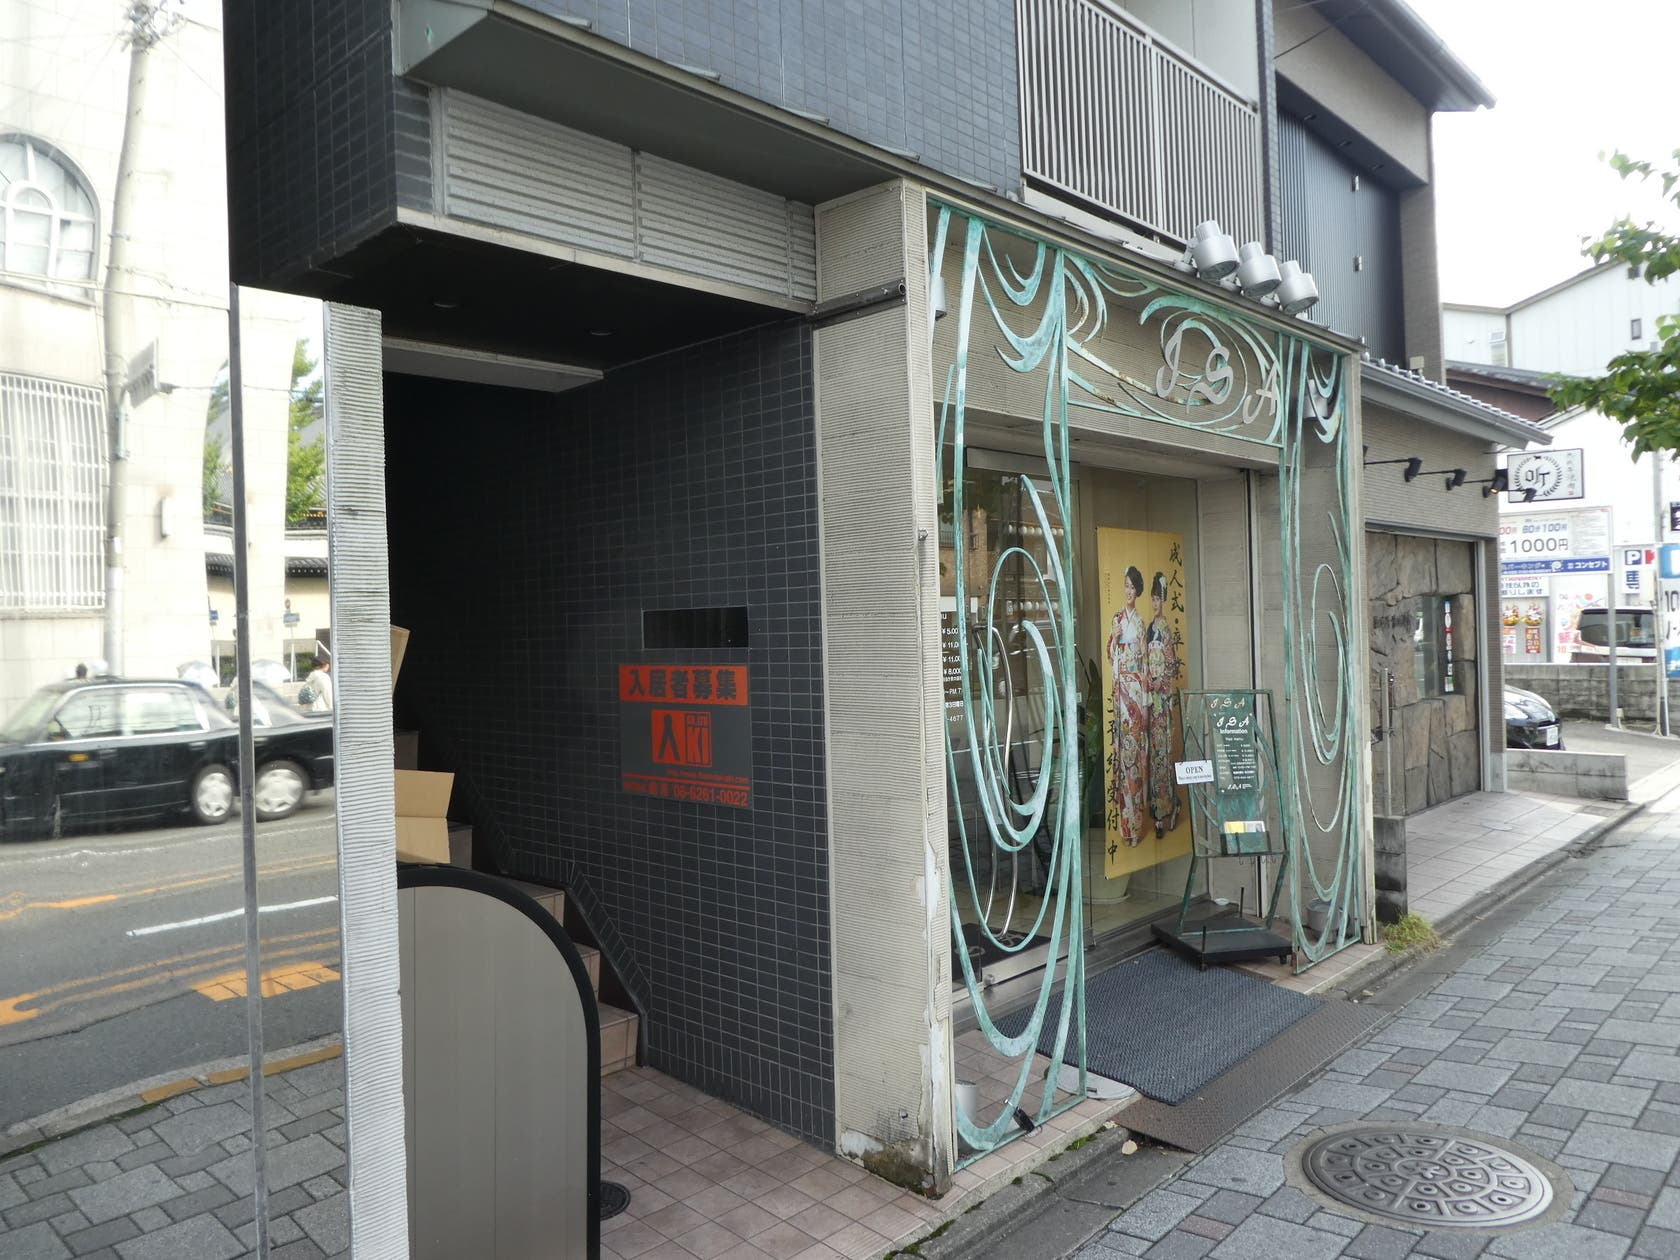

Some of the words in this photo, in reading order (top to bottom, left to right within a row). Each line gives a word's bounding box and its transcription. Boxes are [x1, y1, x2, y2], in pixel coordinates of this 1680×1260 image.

[628, 668, 737, 700] 入居者募集
[1185, 765, 1204, 775] OPEN
